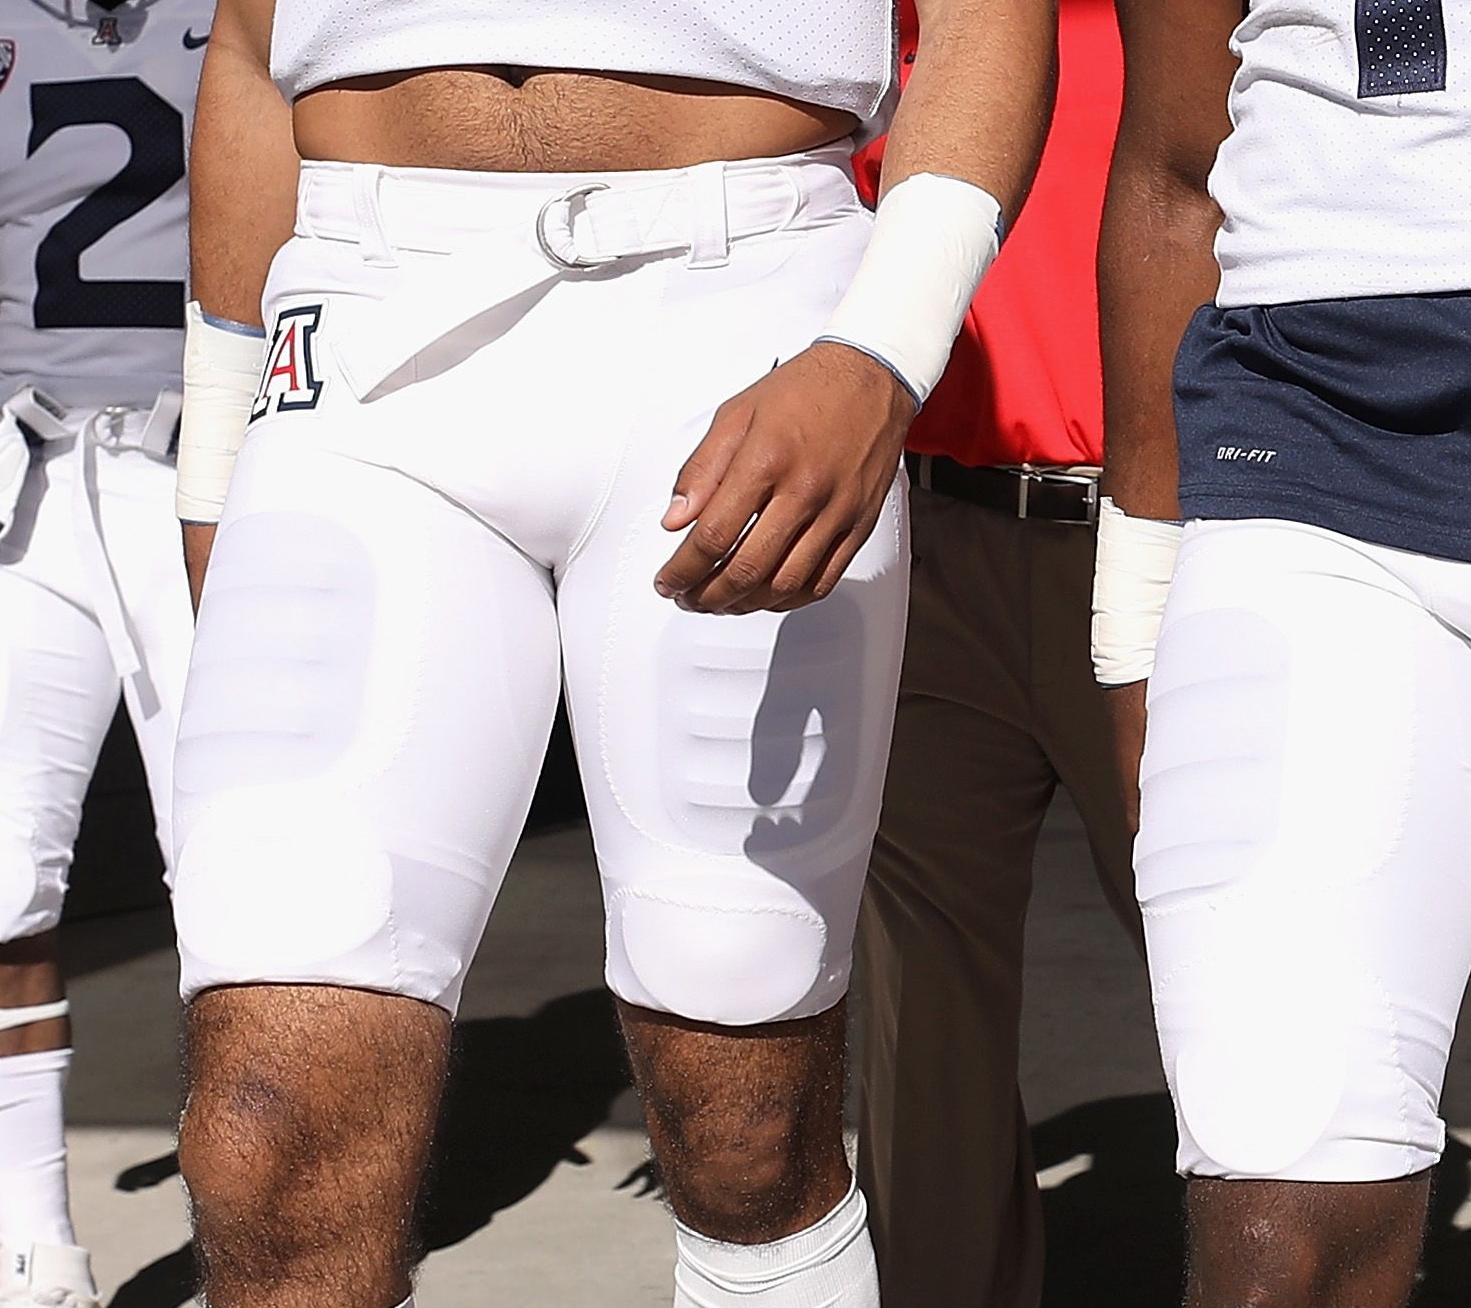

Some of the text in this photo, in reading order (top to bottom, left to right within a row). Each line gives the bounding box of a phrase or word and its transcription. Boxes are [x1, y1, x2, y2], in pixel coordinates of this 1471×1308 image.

[27, 76, 185, 328] 2
[248, 304, 323, 426] A
[1216, 446, 1277, 463] DRI-FIT
